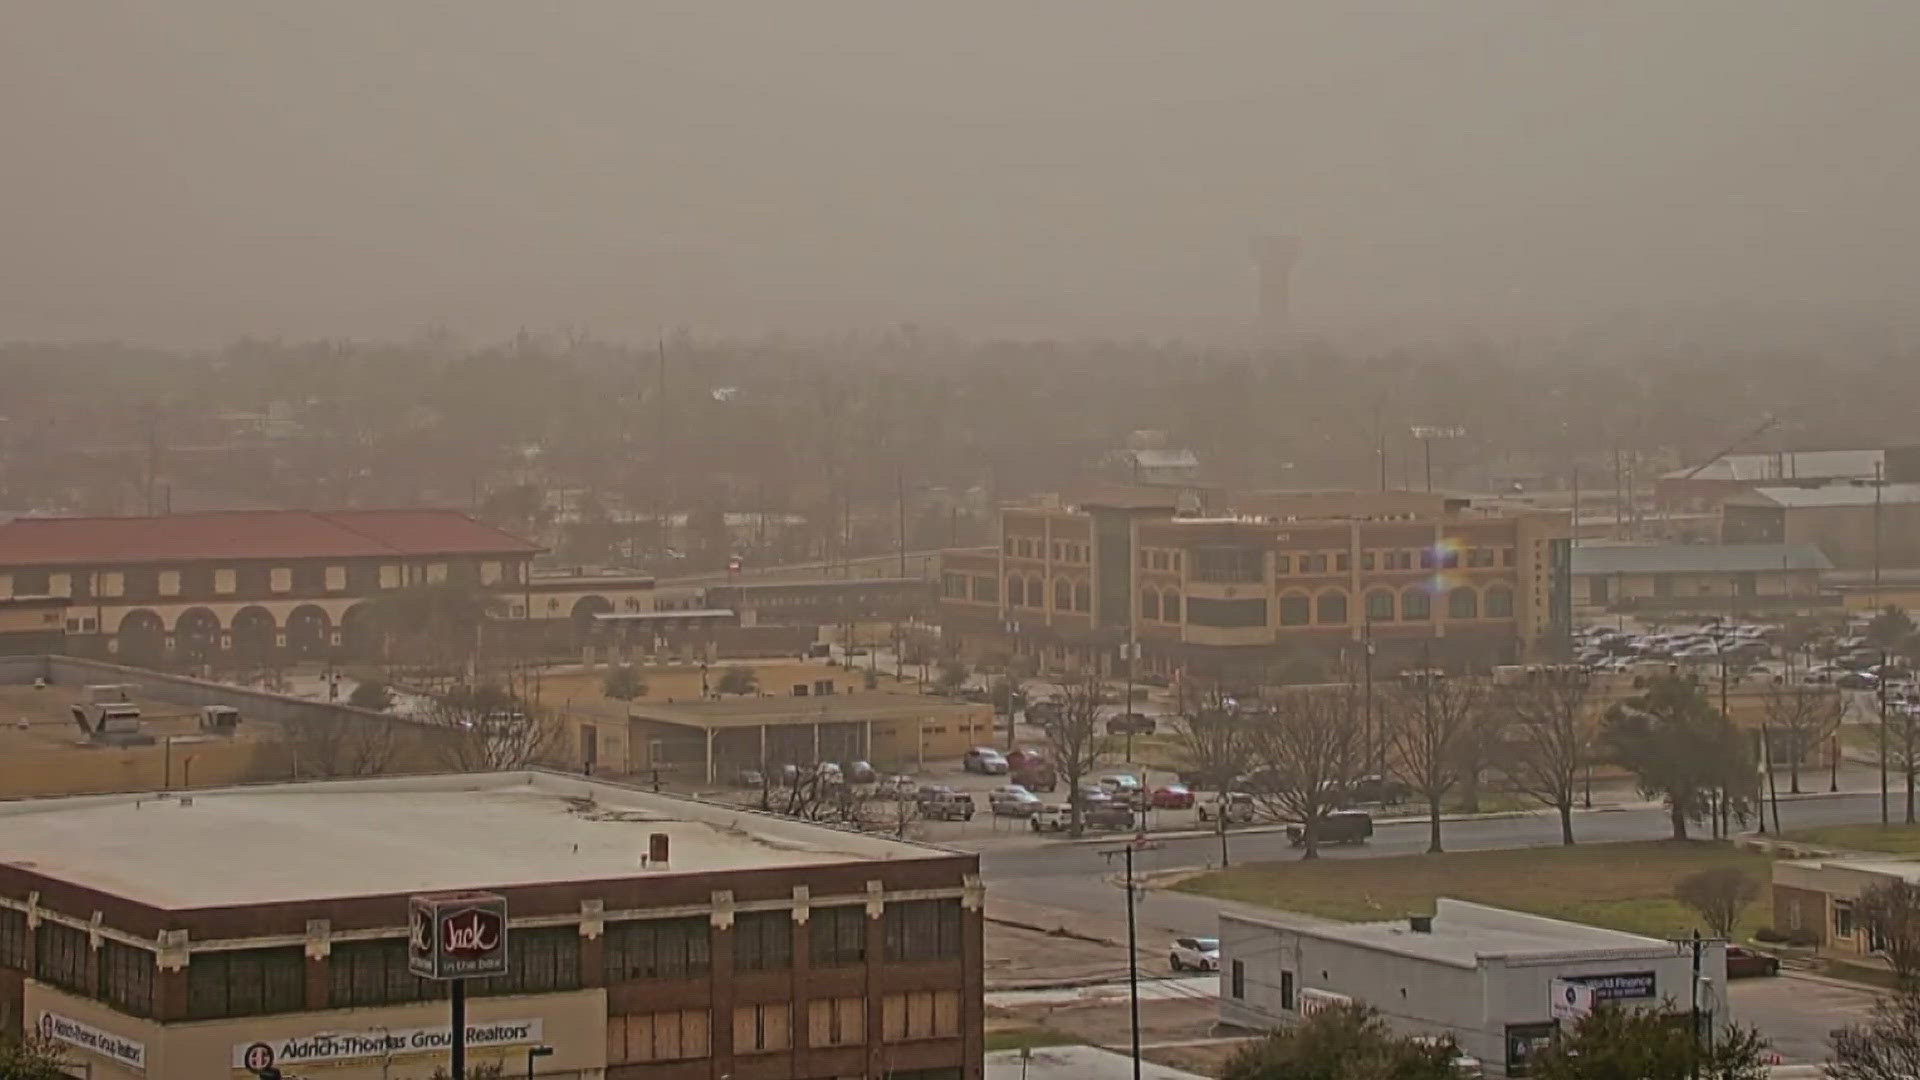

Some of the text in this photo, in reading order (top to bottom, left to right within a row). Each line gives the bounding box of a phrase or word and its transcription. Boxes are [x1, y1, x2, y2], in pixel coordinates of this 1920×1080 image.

[445, 913, 498, 953] Jack
[280, 1032, 405, 1058] Aldrich-Thomas
[411, 1029, 453, 1048] Grou
